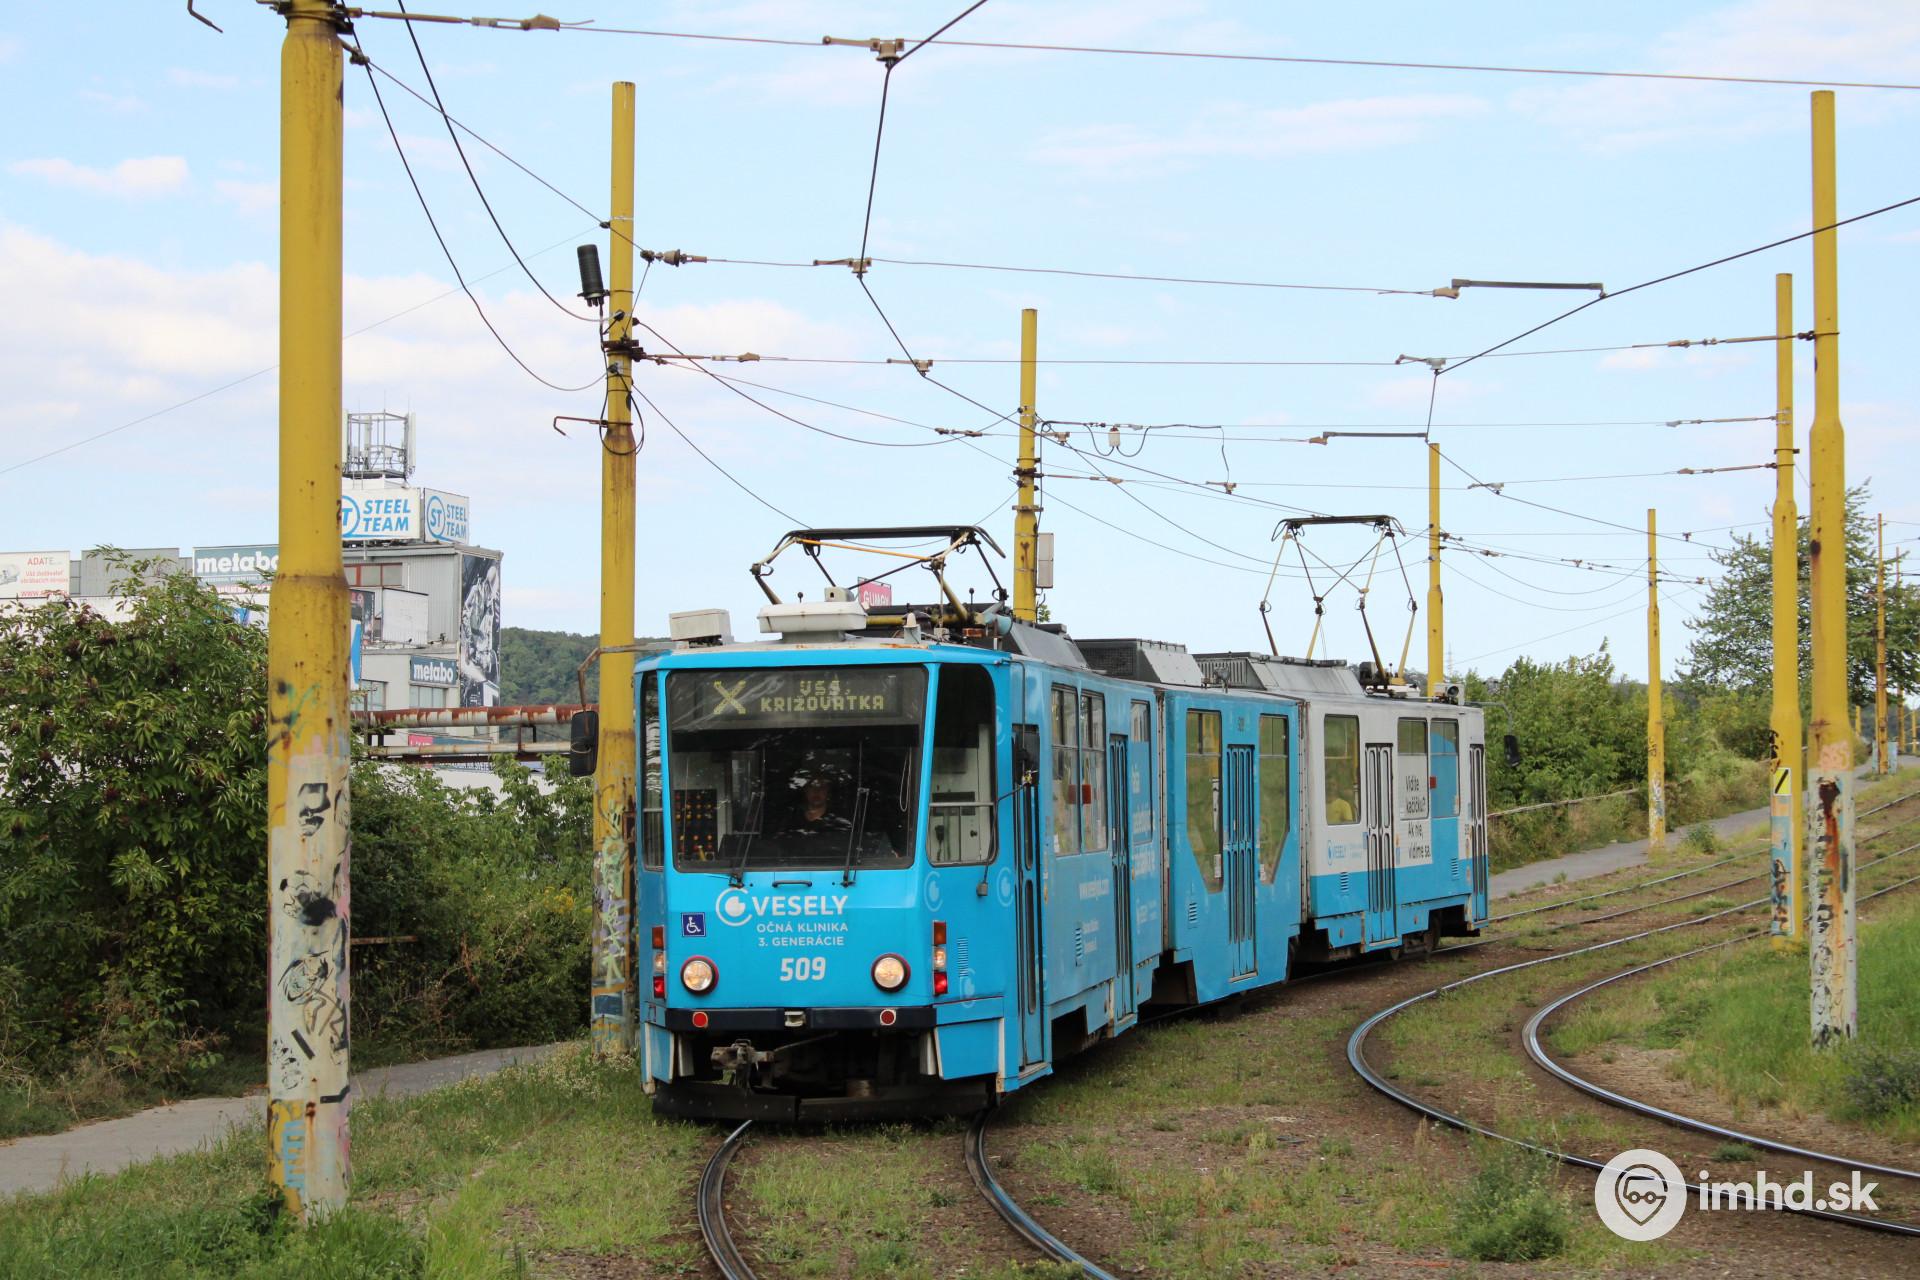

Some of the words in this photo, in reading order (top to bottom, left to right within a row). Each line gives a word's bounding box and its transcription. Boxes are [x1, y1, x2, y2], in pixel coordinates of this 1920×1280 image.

[363, 499, 411, 514] STEEL
[446, 504, 467, 522] STEEL
[363, 517, 409, 532] TEAM
[431, 509, 442, 527] ST
[446, 522, 466, 537] TEAM
[413, 662, 454, 682] metabo
[752, 895, 848, 916] VESELY
[757, 921, 793, 933] OČNÁ
[798, 922, 848, 932] KLINIKA
[758, 937, 768, 946] 3.
[772, 935, 845, 946] GENERÁCIE
[780, 957, 826, 981] 509
